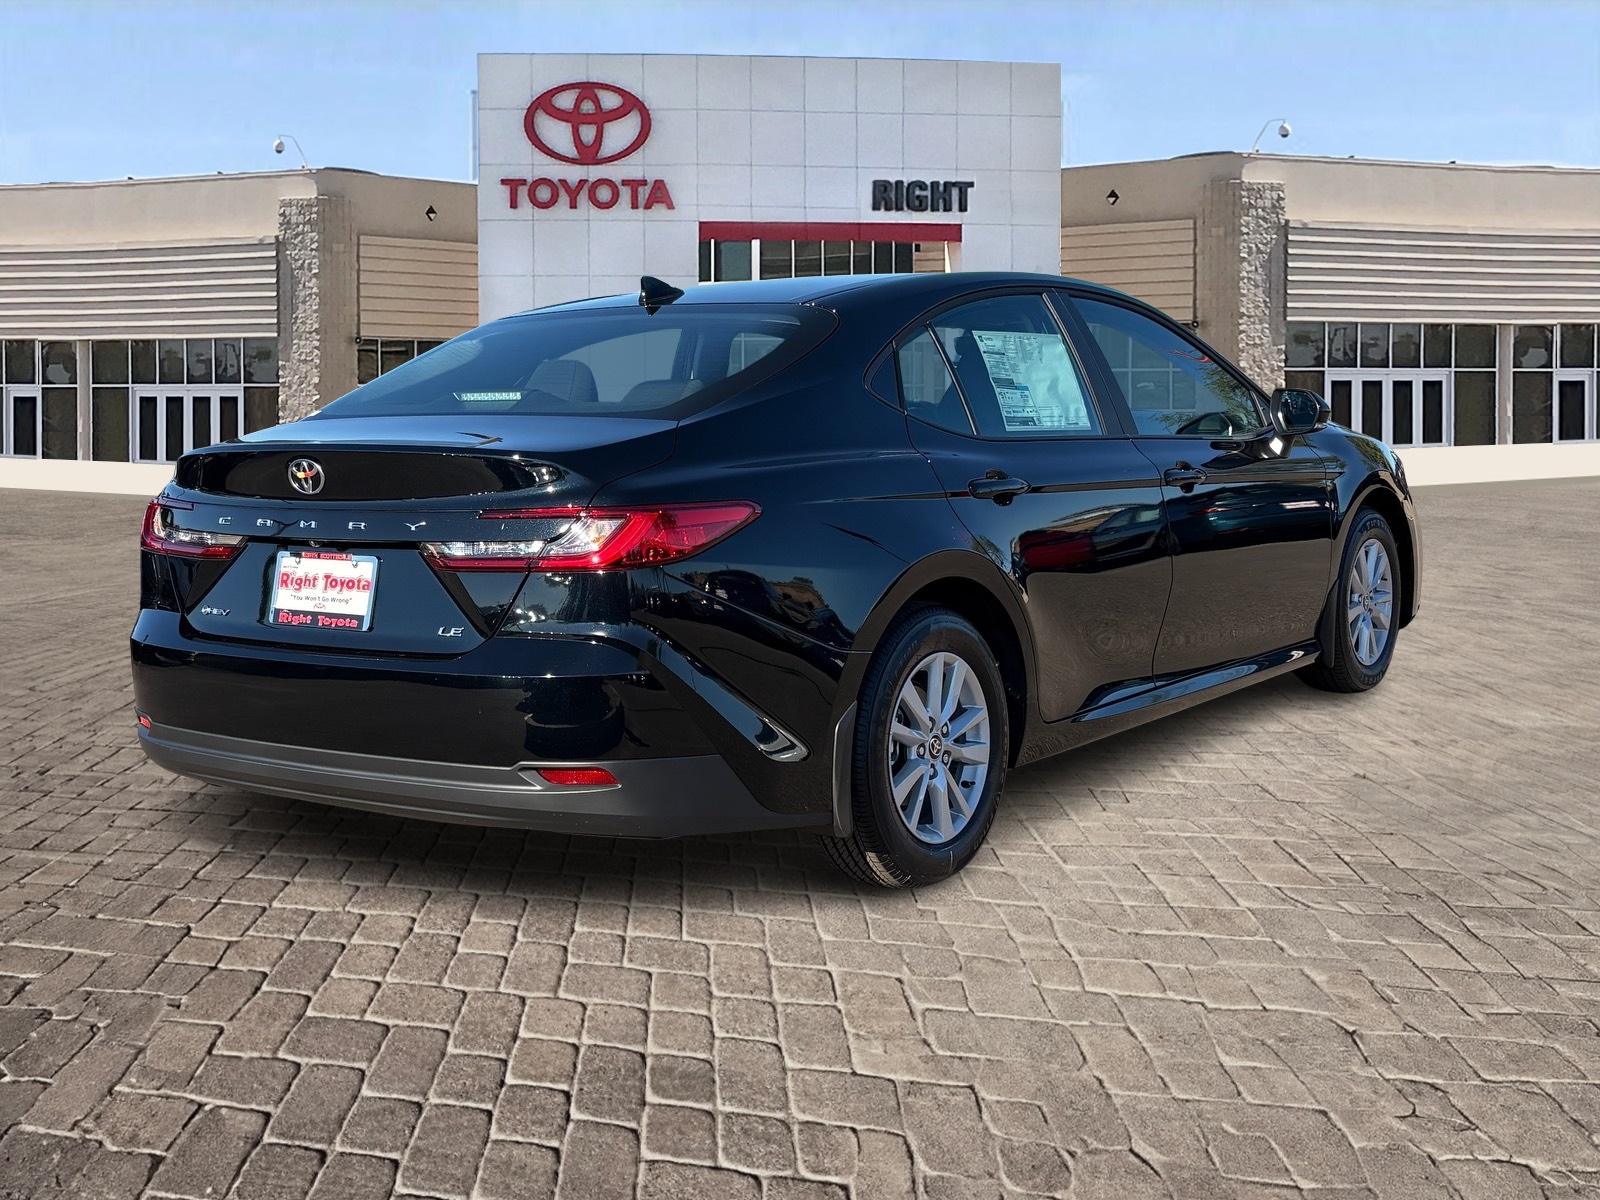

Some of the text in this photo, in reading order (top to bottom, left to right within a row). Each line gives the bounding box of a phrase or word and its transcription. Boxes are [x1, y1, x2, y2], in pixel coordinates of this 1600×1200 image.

[500, 178, 675, 210] TOYOTA
[872, 179, 976, 213] RIGHT
[217, 516, 427, 532] CAMRY
[280, 572, 372, 593] Right Toyota
[278, 611, 358, 627] Right Toyota
[437, 626, 465, 637] LE
